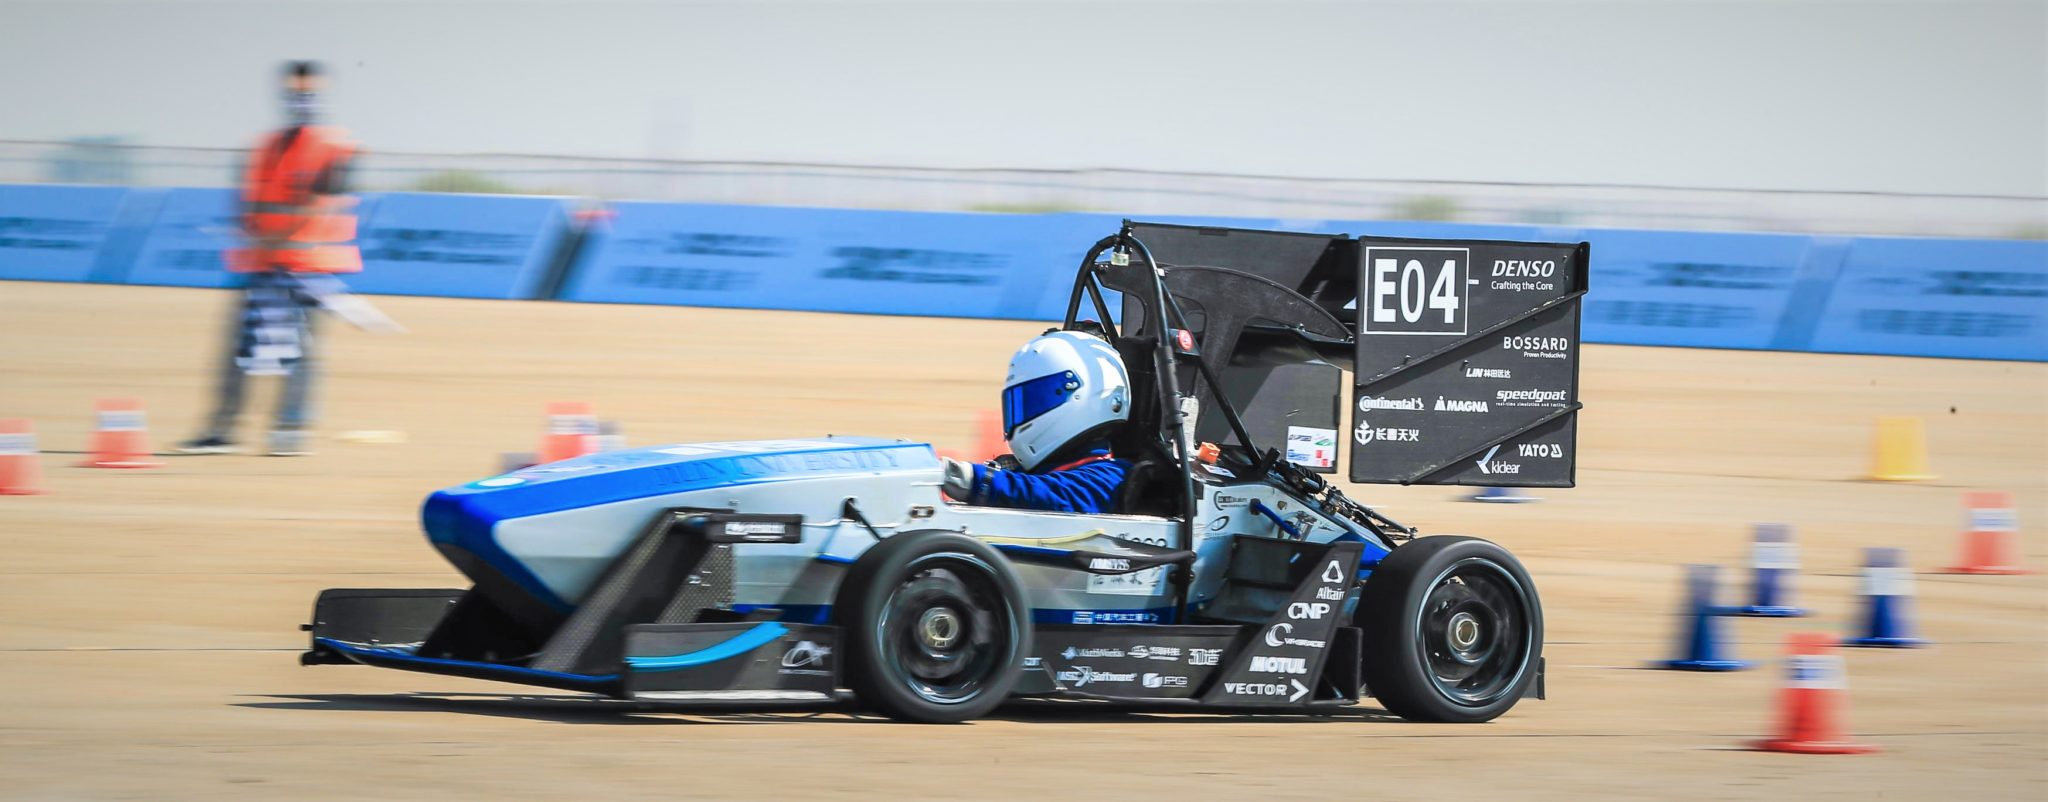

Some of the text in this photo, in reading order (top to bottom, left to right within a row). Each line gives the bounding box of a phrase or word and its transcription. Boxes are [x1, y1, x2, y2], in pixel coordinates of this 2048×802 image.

[1492, 260, 1555, 277] DENSO
[1373, 259, 1459, 323] E04
[1491, 281, 1554, 292] Crafting the Core
[1503, 336, 1568, 351] BOSSARD
[1540, 352, 1567, 360] Productivity
[1465, 368, 1484, 378] LIN
[1496, 388, 1567, 403] speedgoat
[1359, 395, 1415, 412] Continental
[1446, 400, 1489, 413] MAGNA
[1518, 443, 1549, 458] YATO
[1316, 587, 1345, 600] Altair
[1287, 602, 1331, 619] CNP
[1249, 656, 1308, 674] MOTUL
[1224, 682, 1288, 696] VECTOR
